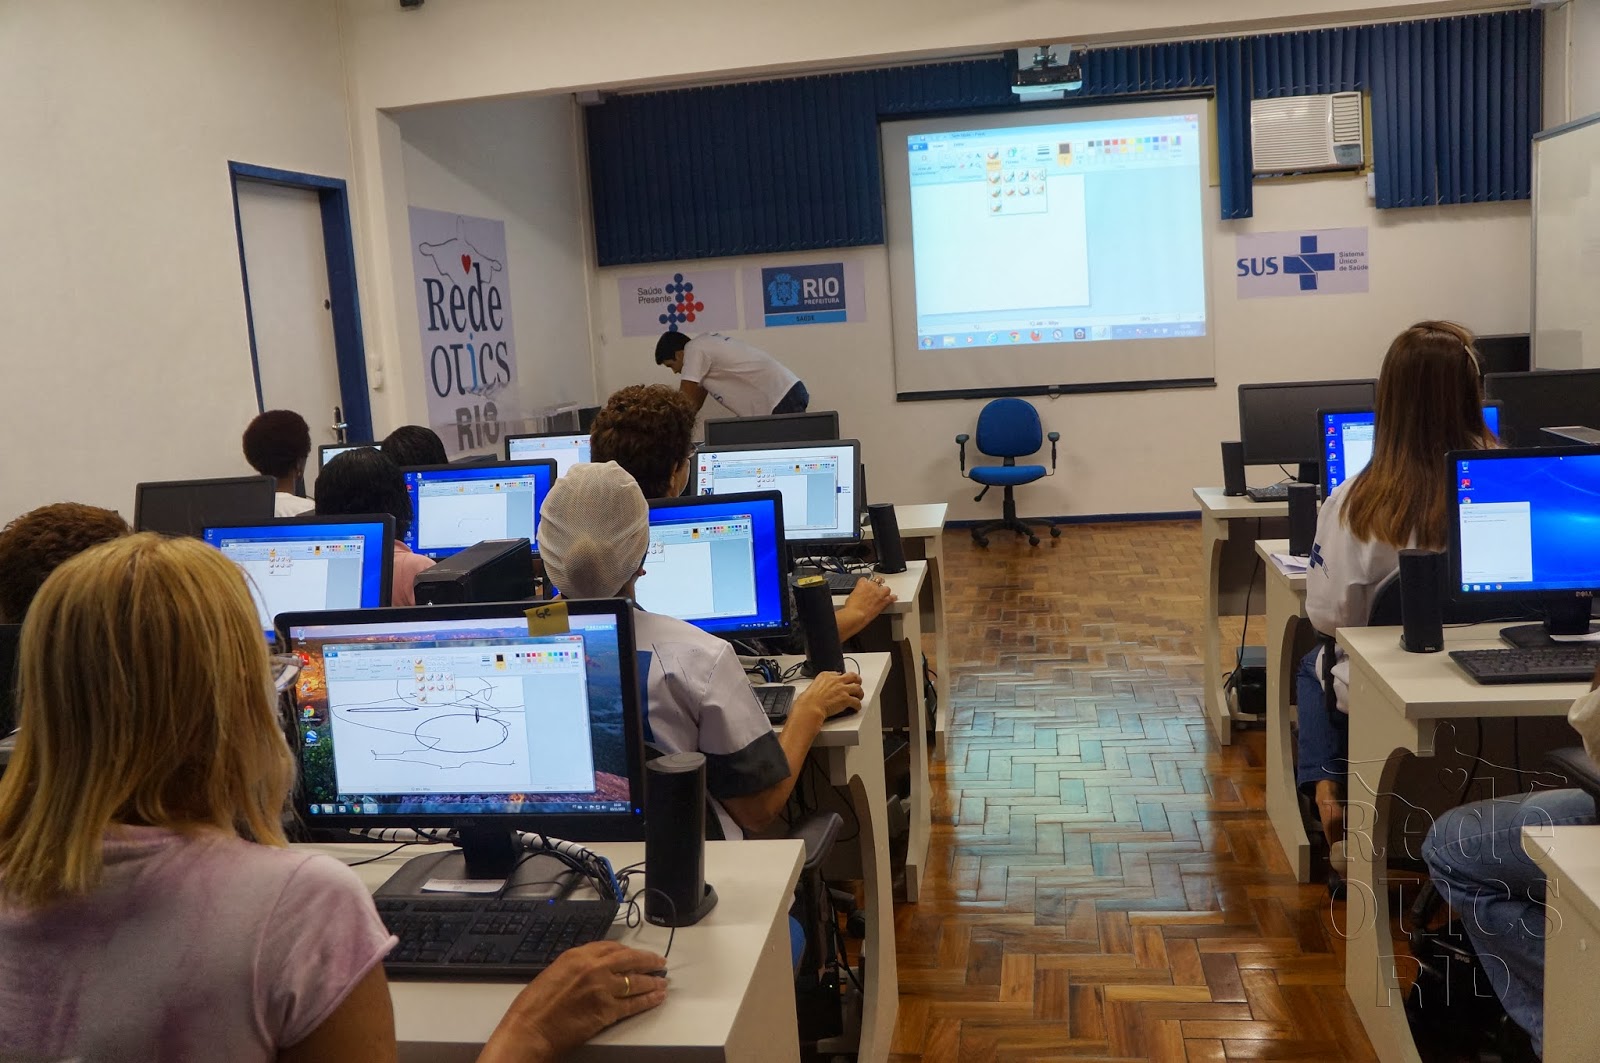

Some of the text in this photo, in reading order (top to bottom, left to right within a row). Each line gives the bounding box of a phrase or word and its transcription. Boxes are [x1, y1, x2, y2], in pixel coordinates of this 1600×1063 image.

[1236, 256, 1279, 277] SUS
[423, 262, 503, 333] Rede
[637, 286, 663, 296] Saúde
[802, 276, 840, 299] RIO
[637, 295, 672, 304] Presente
[803, 297, 840, 305] PREFEITURA
[456, 401, 500, 451] RIO
